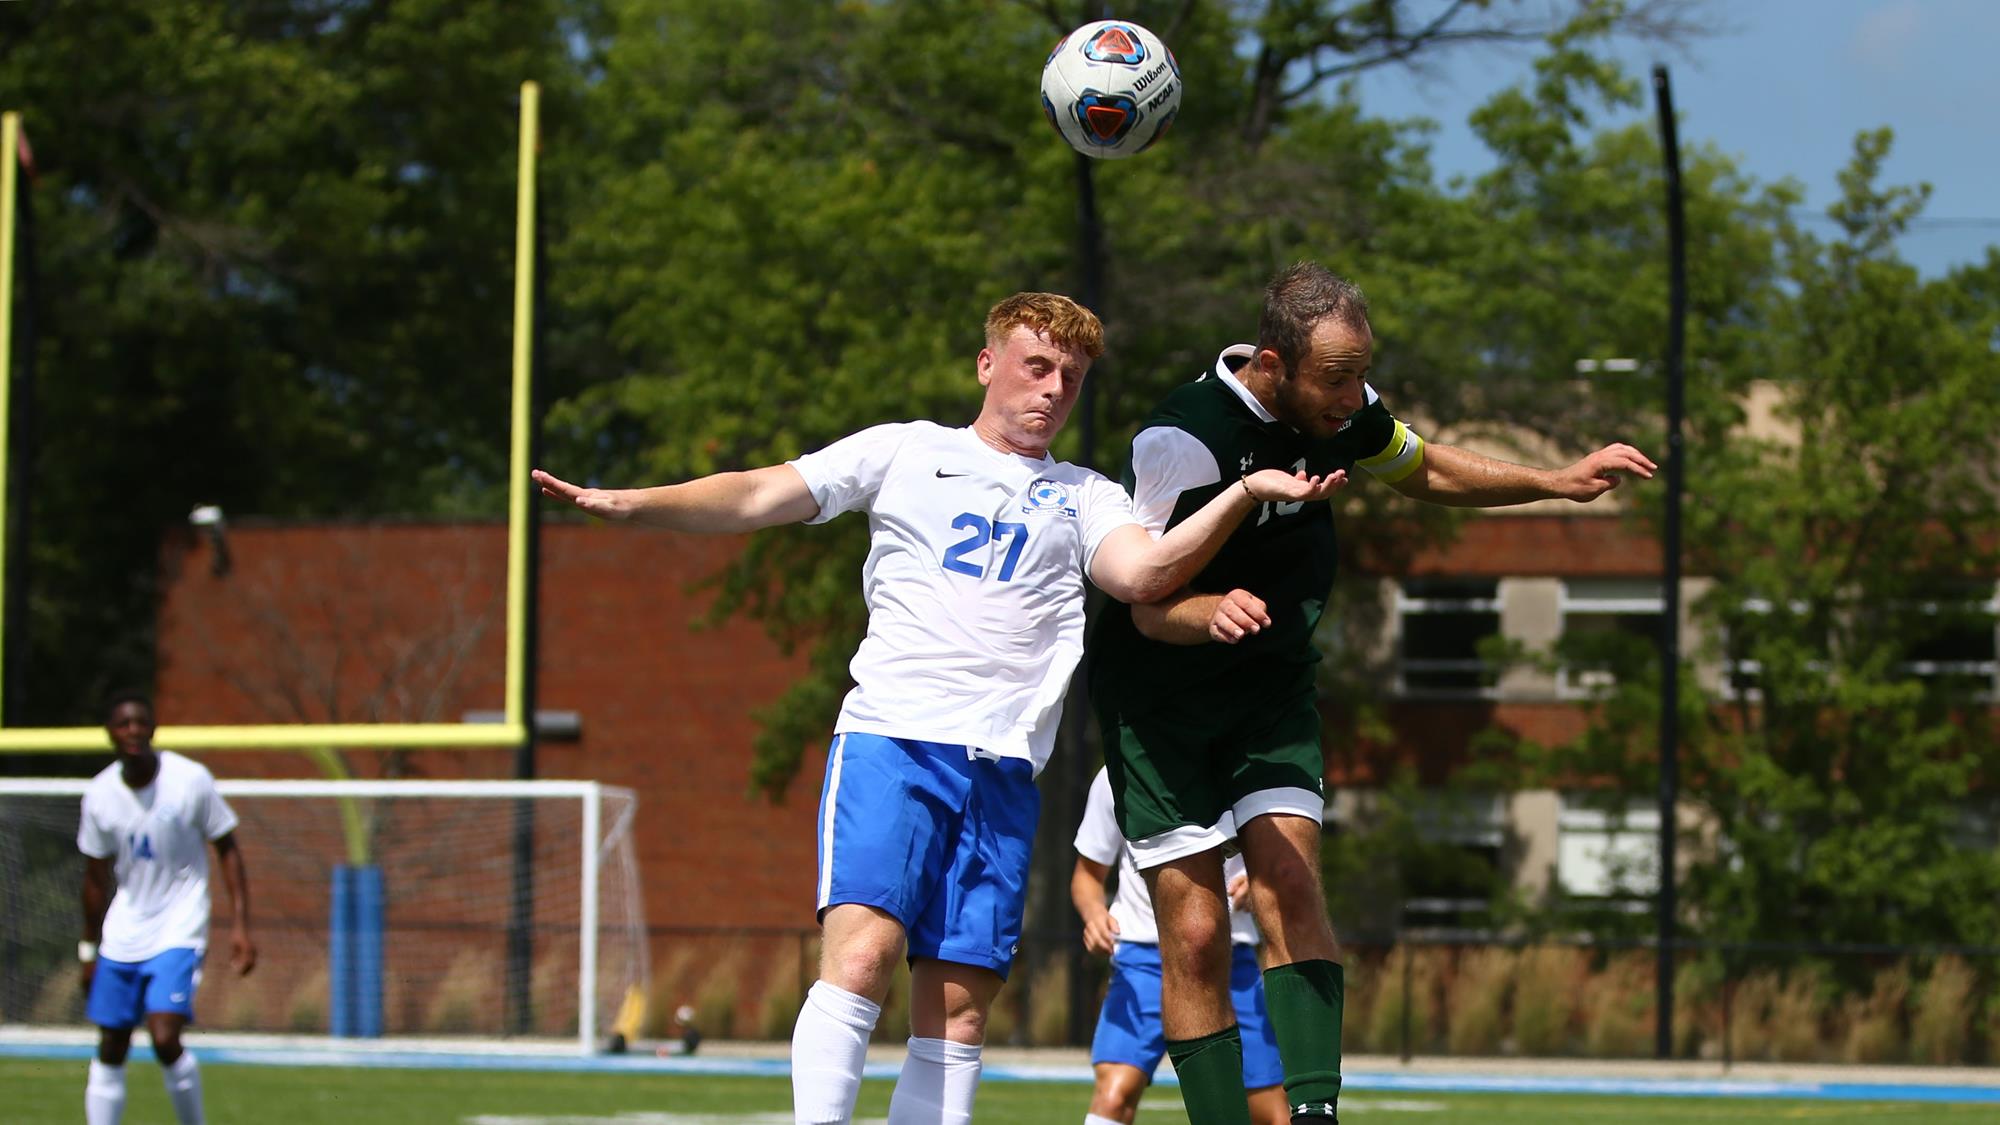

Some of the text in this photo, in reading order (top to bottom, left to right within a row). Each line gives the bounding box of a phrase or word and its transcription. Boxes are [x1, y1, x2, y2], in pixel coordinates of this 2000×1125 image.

[1132, 62, 1167, 92] Wilson
[1147, 83, 1174, 112] NCAA
[942, 511, 1029, 582] 27
[129, 833, 155, 861] 14
